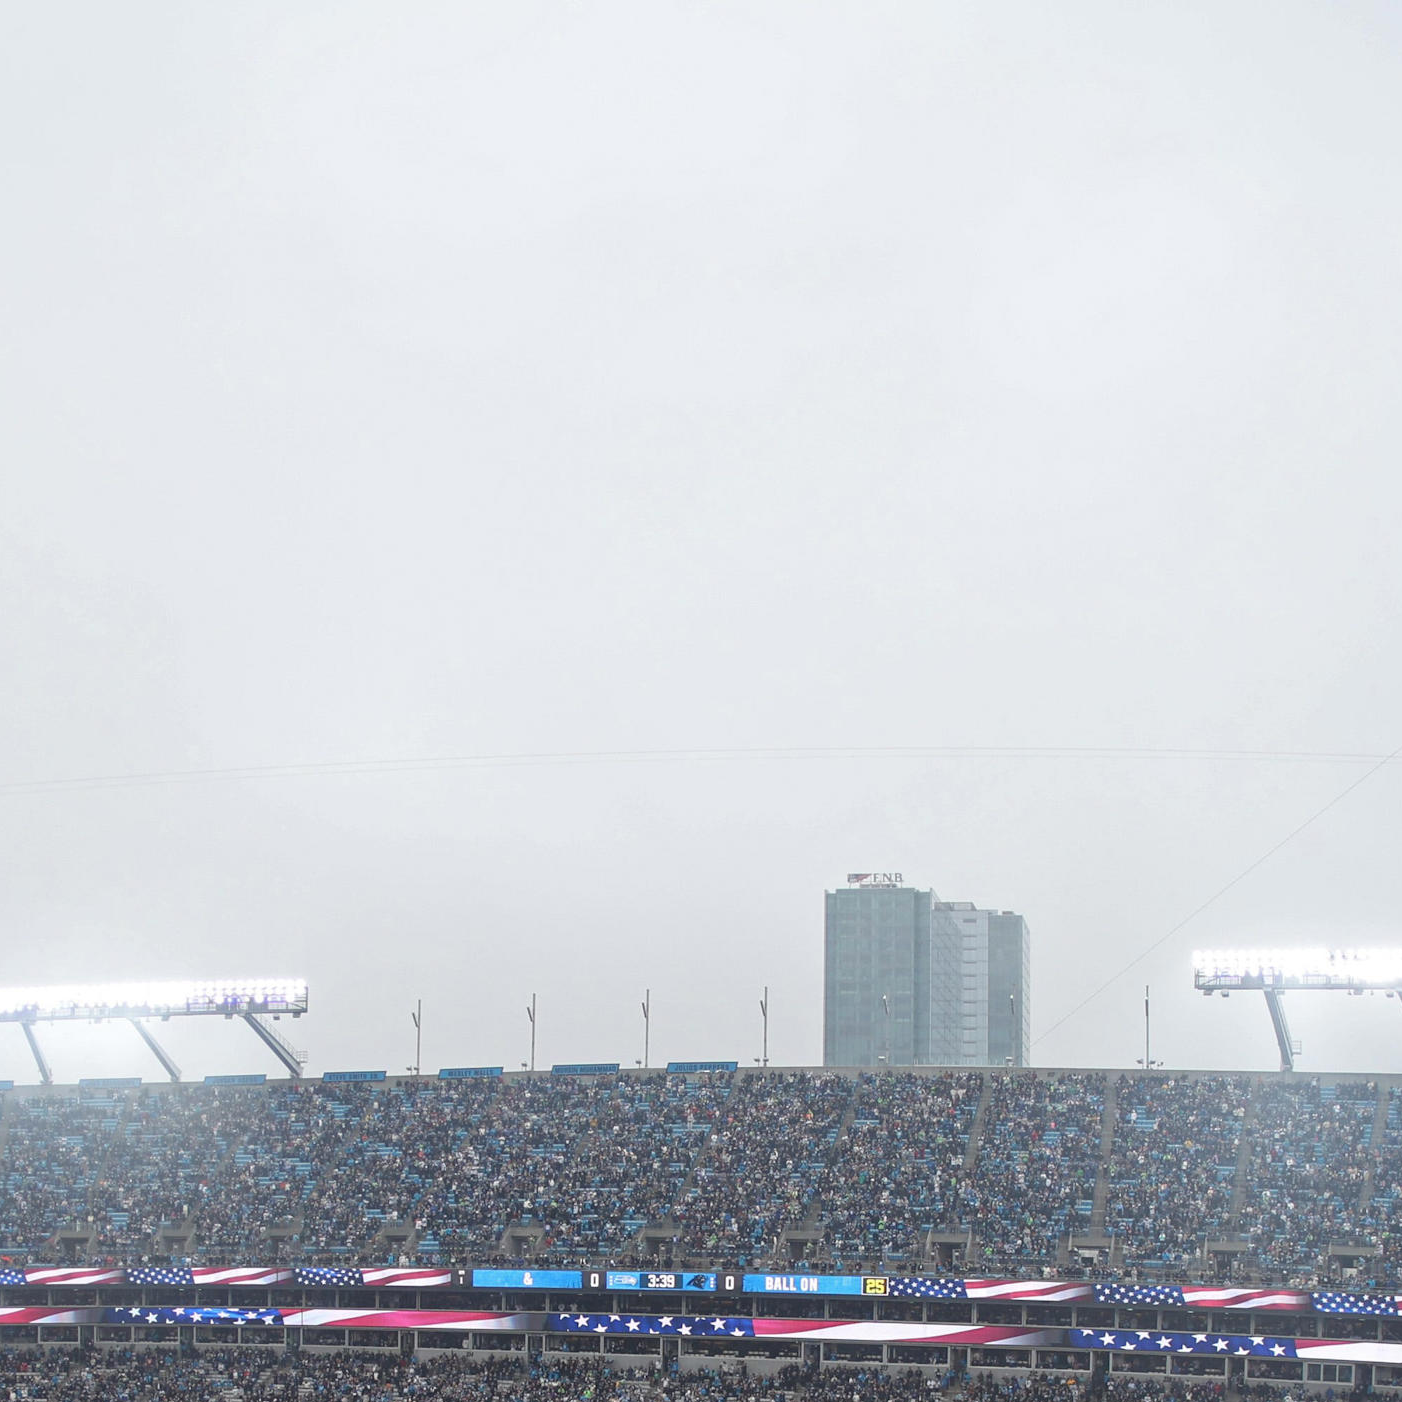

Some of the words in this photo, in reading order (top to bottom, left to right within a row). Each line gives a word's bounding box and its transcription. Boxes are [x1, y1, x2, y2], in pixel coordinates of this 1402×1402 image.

[590, 1273, 599, 1287] 0
[648, 1274, 675, 1288] 3:39
[725, 1275, 734, 1290] 0
[765, 1277, 797, 1291] BALL
[800, 1277, 818, 1291] ON
[865, 1279, 884, 1294] 25
